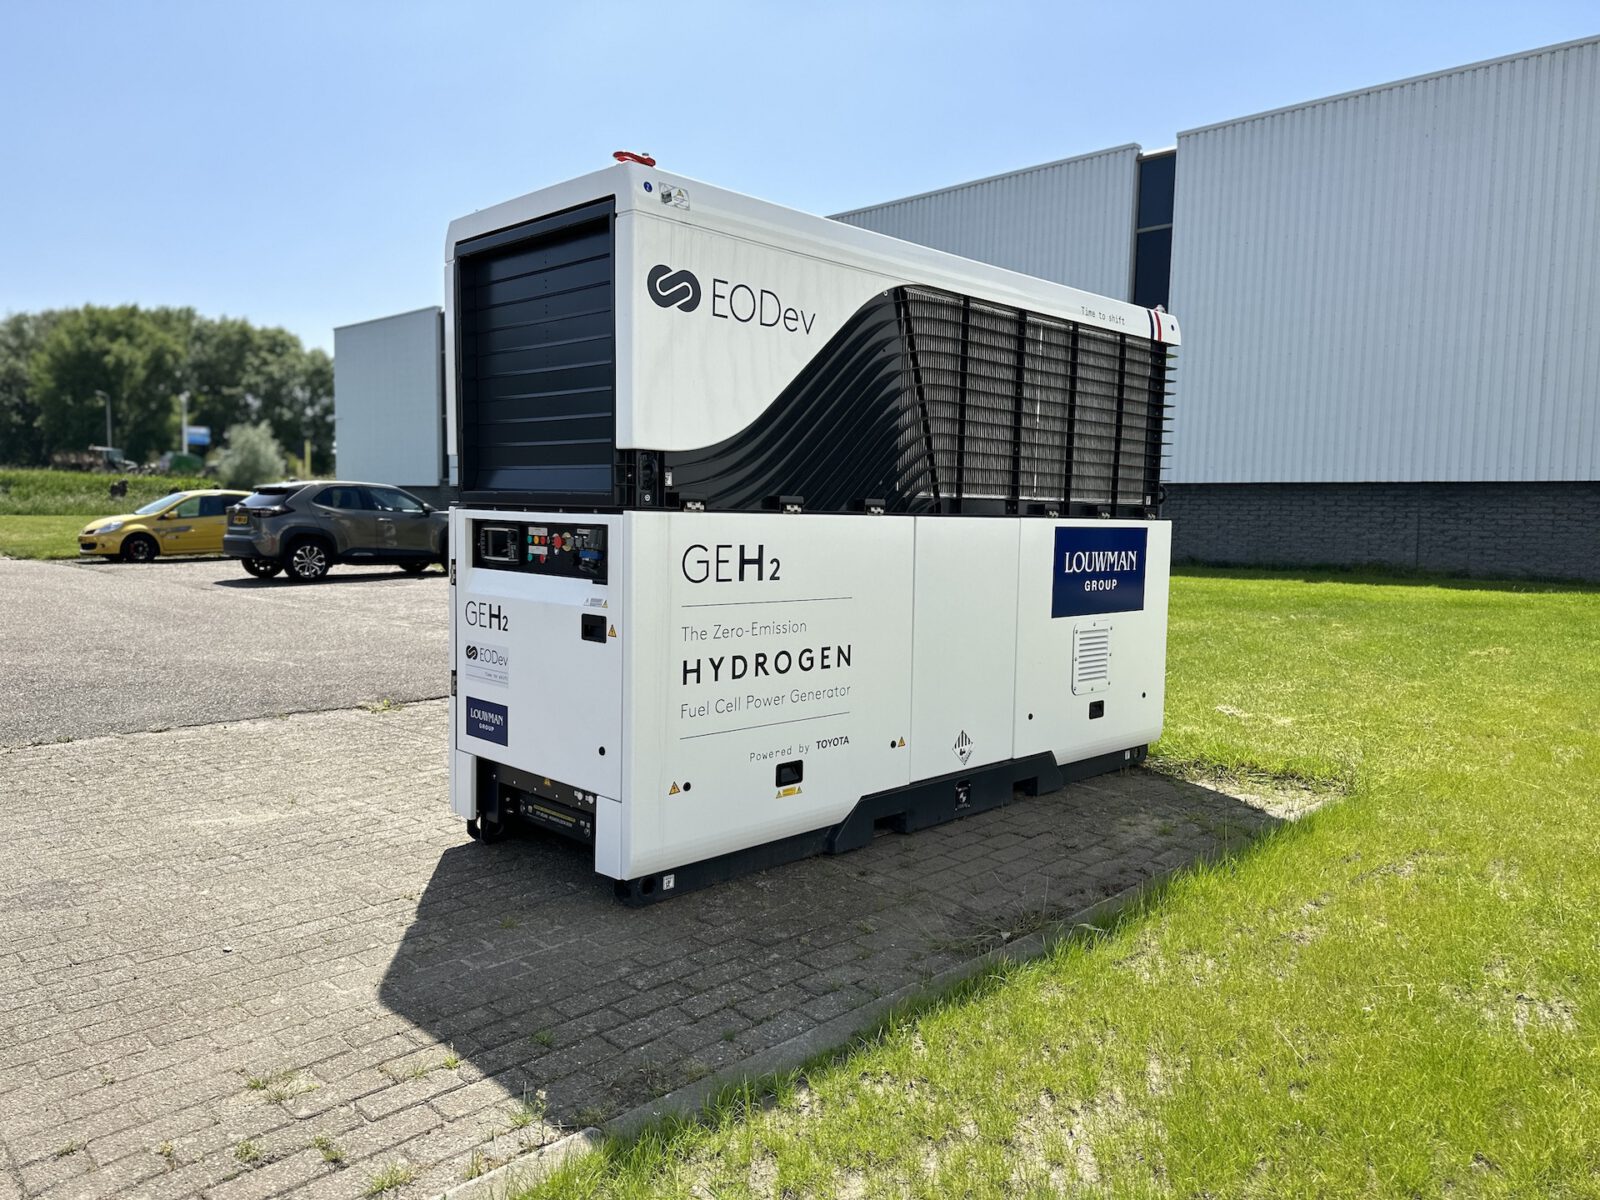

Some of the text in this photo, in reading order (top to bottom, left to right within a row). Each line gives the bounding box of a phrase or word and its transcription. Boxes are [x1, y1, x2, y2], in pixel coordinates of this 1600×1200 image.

[712, 278, 816, 335] EODev
[1081, 306, 1125, 326] Time to shift
[681, 544, 781, 584] GEH2
[1064, 550, 1137, 573] LOUWMAN
[1084, 579, 1118, 592] GROUP
[681, 619, 807, 642] The Zero-Emission
[479, 647, 509, 667] EODev
[682, 644, 852, 686] HYDROGEN
[680, 685, 851, 719] Fuel Cell Power Generator
[470, 707, 504, 727] LOUWMAN
[749, 735, 850, 762] Powered by TOYOTA
